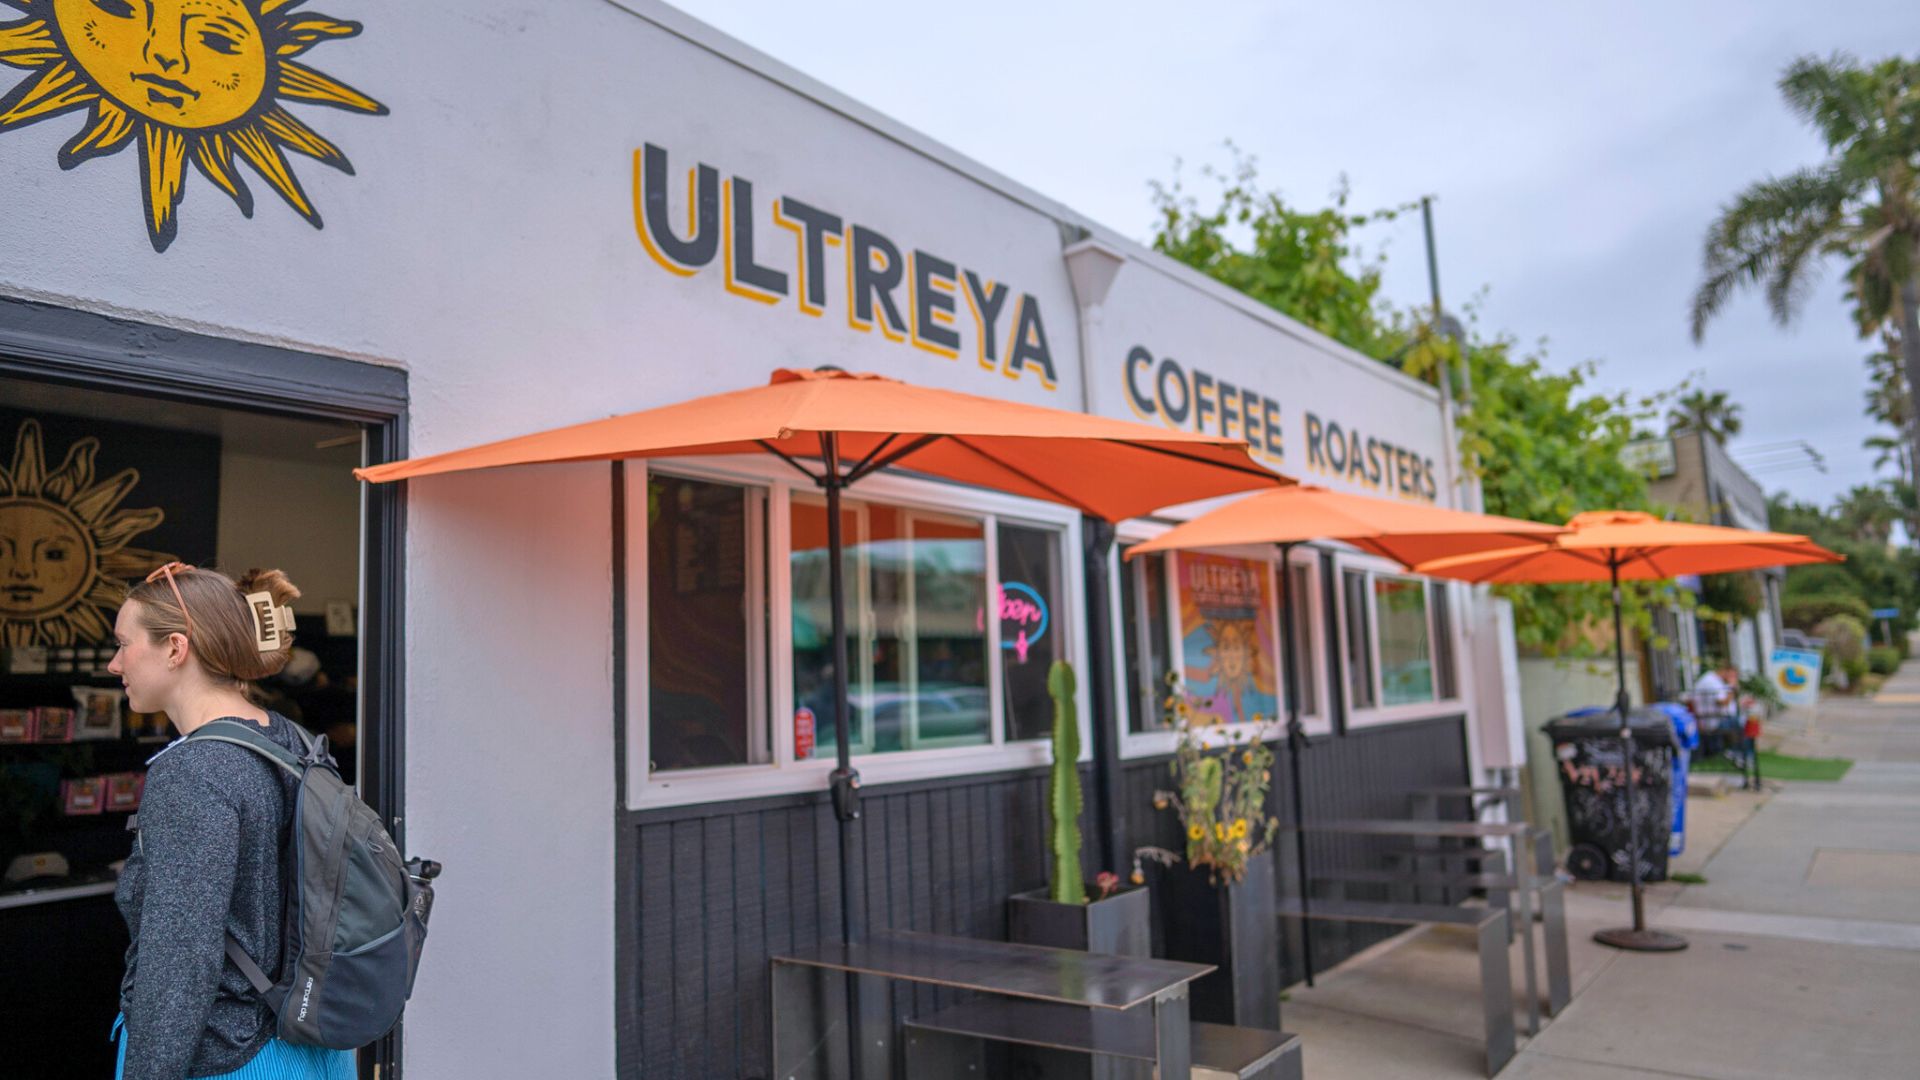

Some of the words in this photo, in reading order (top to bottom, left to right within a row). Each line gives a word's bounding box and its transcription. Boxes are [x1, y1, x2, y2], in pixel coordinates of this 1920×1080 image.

[633, 142, 1058, 391] ULTREYA
[1122, 345, 1284, 463] COFFEE
[1301, 409, 1437, 500] ROASTERS
